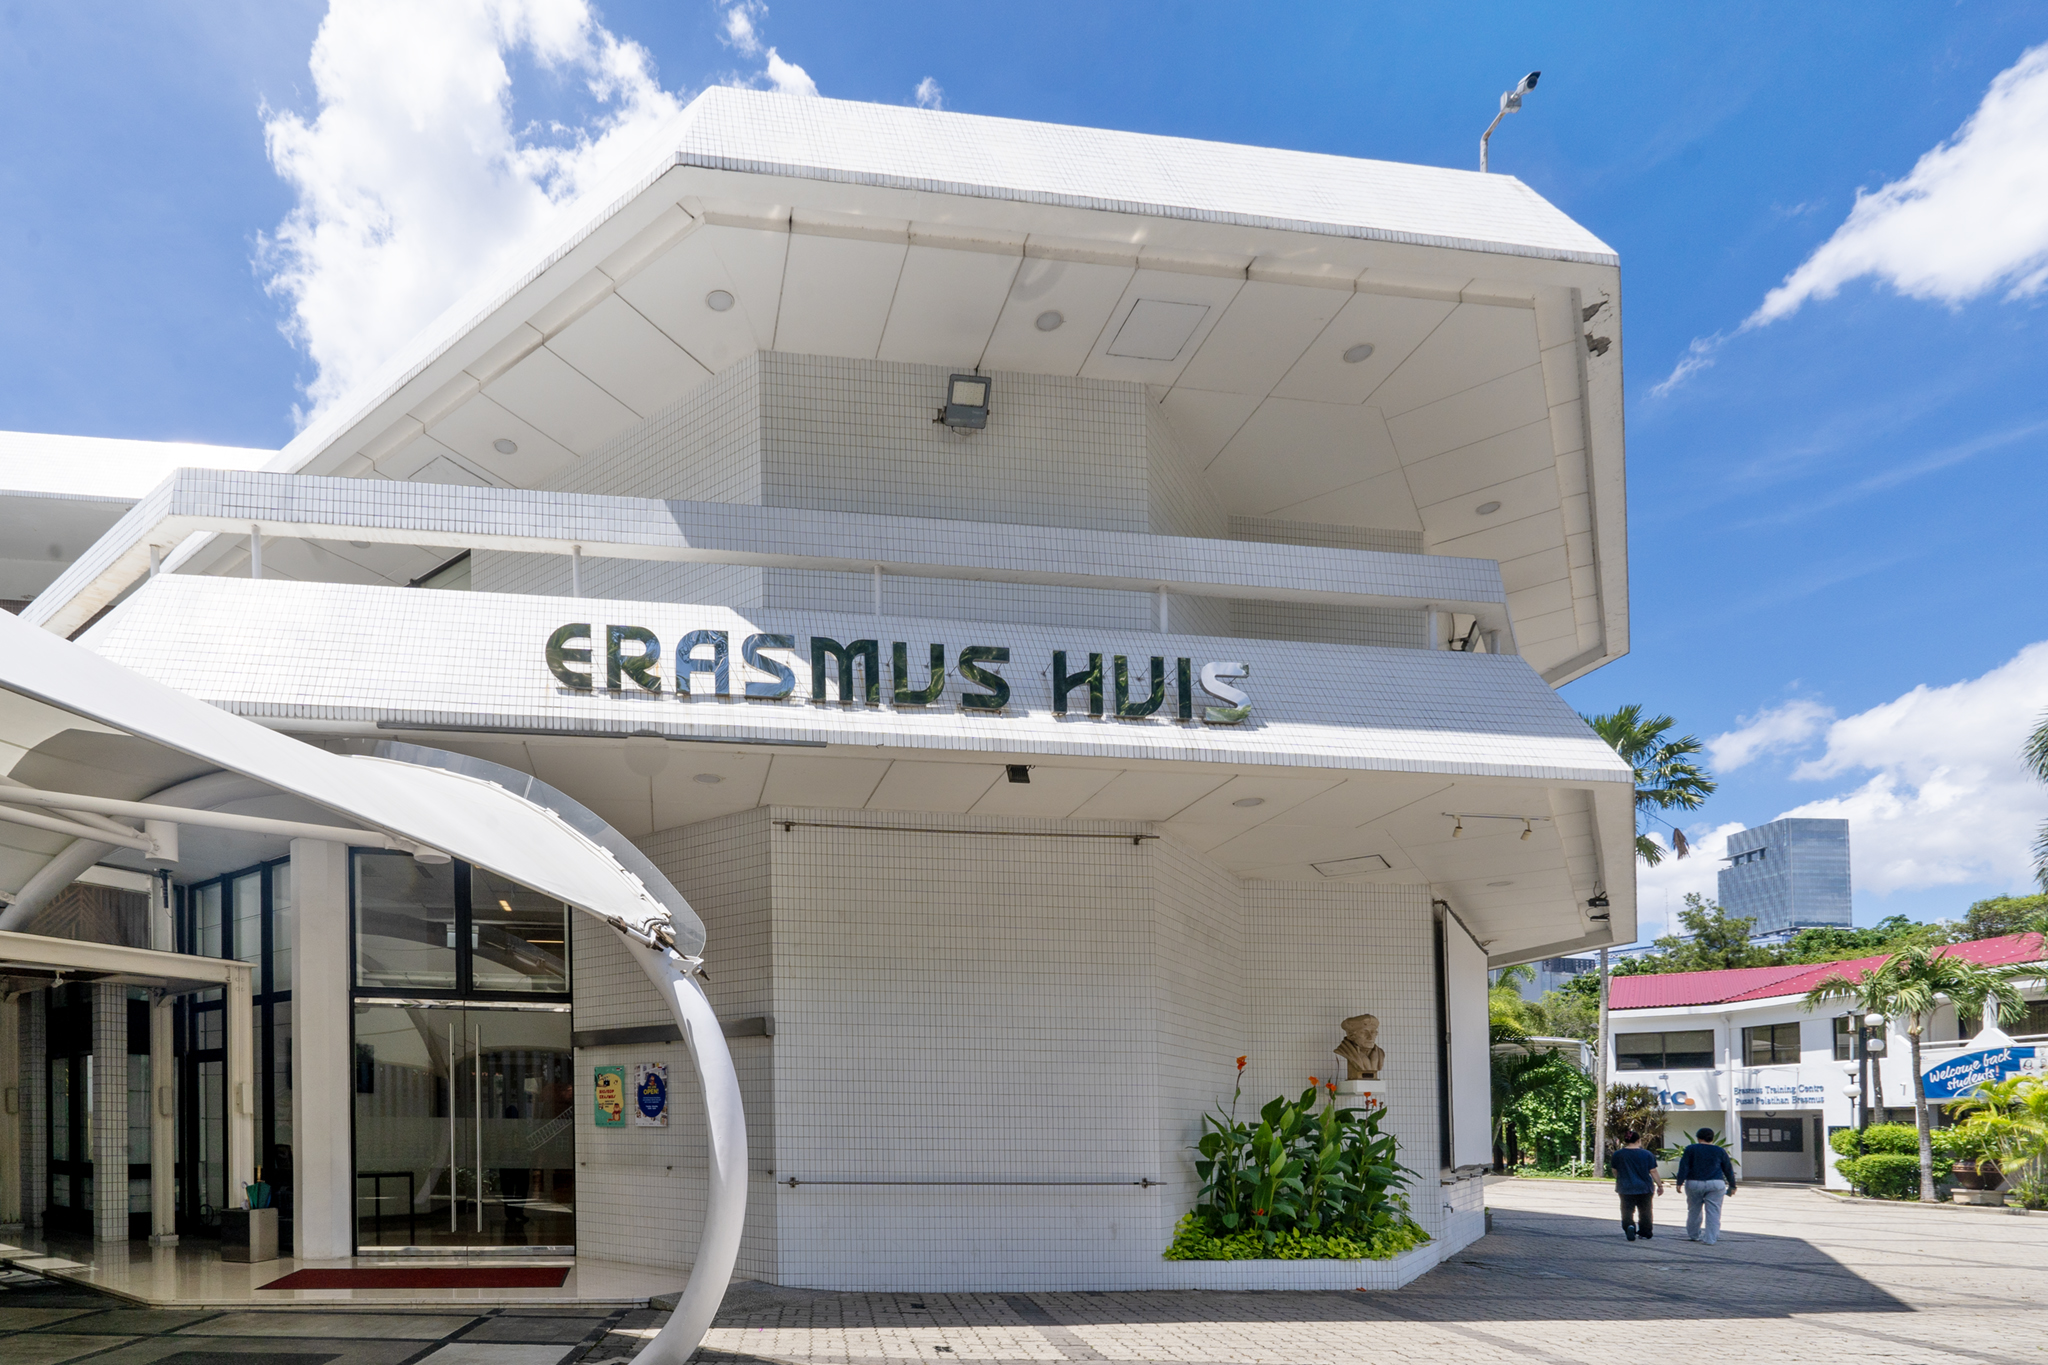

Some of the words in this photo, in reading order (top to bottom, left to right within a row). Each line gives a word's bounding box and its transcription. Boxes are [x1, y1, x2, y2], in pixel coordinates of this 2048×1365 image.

[545, 622, 1010, 710] ERASMUS
[1053, 650, 1252, 724] HUIS
[1929, 1060, 1981, 1083] Welcome
[1983, 1048, 2012, 1067] back
[1946, 1065, 2000, 1091] students!
[1734, 1087, 1763, 1095] Erasmus
[1765, 1085, 1797, 1095] Training
[1798, 1084, 1825, 1093] Centre
[1735, 1097, 1754, 1105] Pusat
[1792, 1095, 1825, 1104] Erasmus
